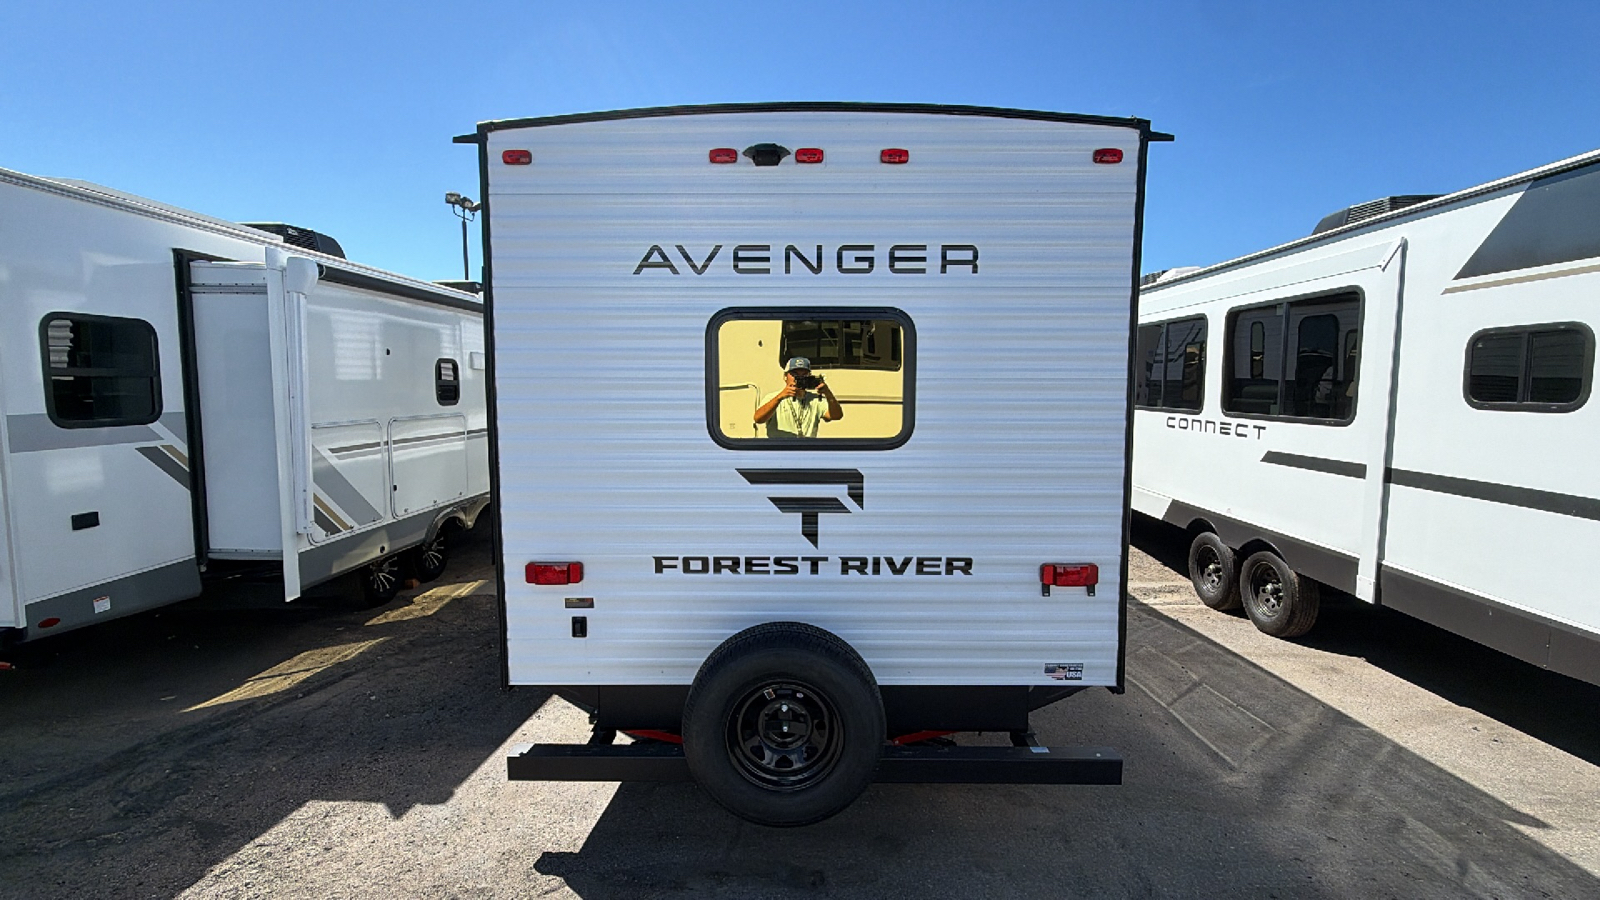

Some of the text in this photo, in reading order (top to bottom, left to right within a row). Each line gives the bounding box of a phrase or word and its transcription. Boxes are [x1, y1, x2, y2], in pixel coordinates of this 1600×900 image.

[633, 244, 979, 275] AVENGER
[1166, 416, 1267, 440] CONNECT
[653, 556, 974, 576] FOREST RIVER
